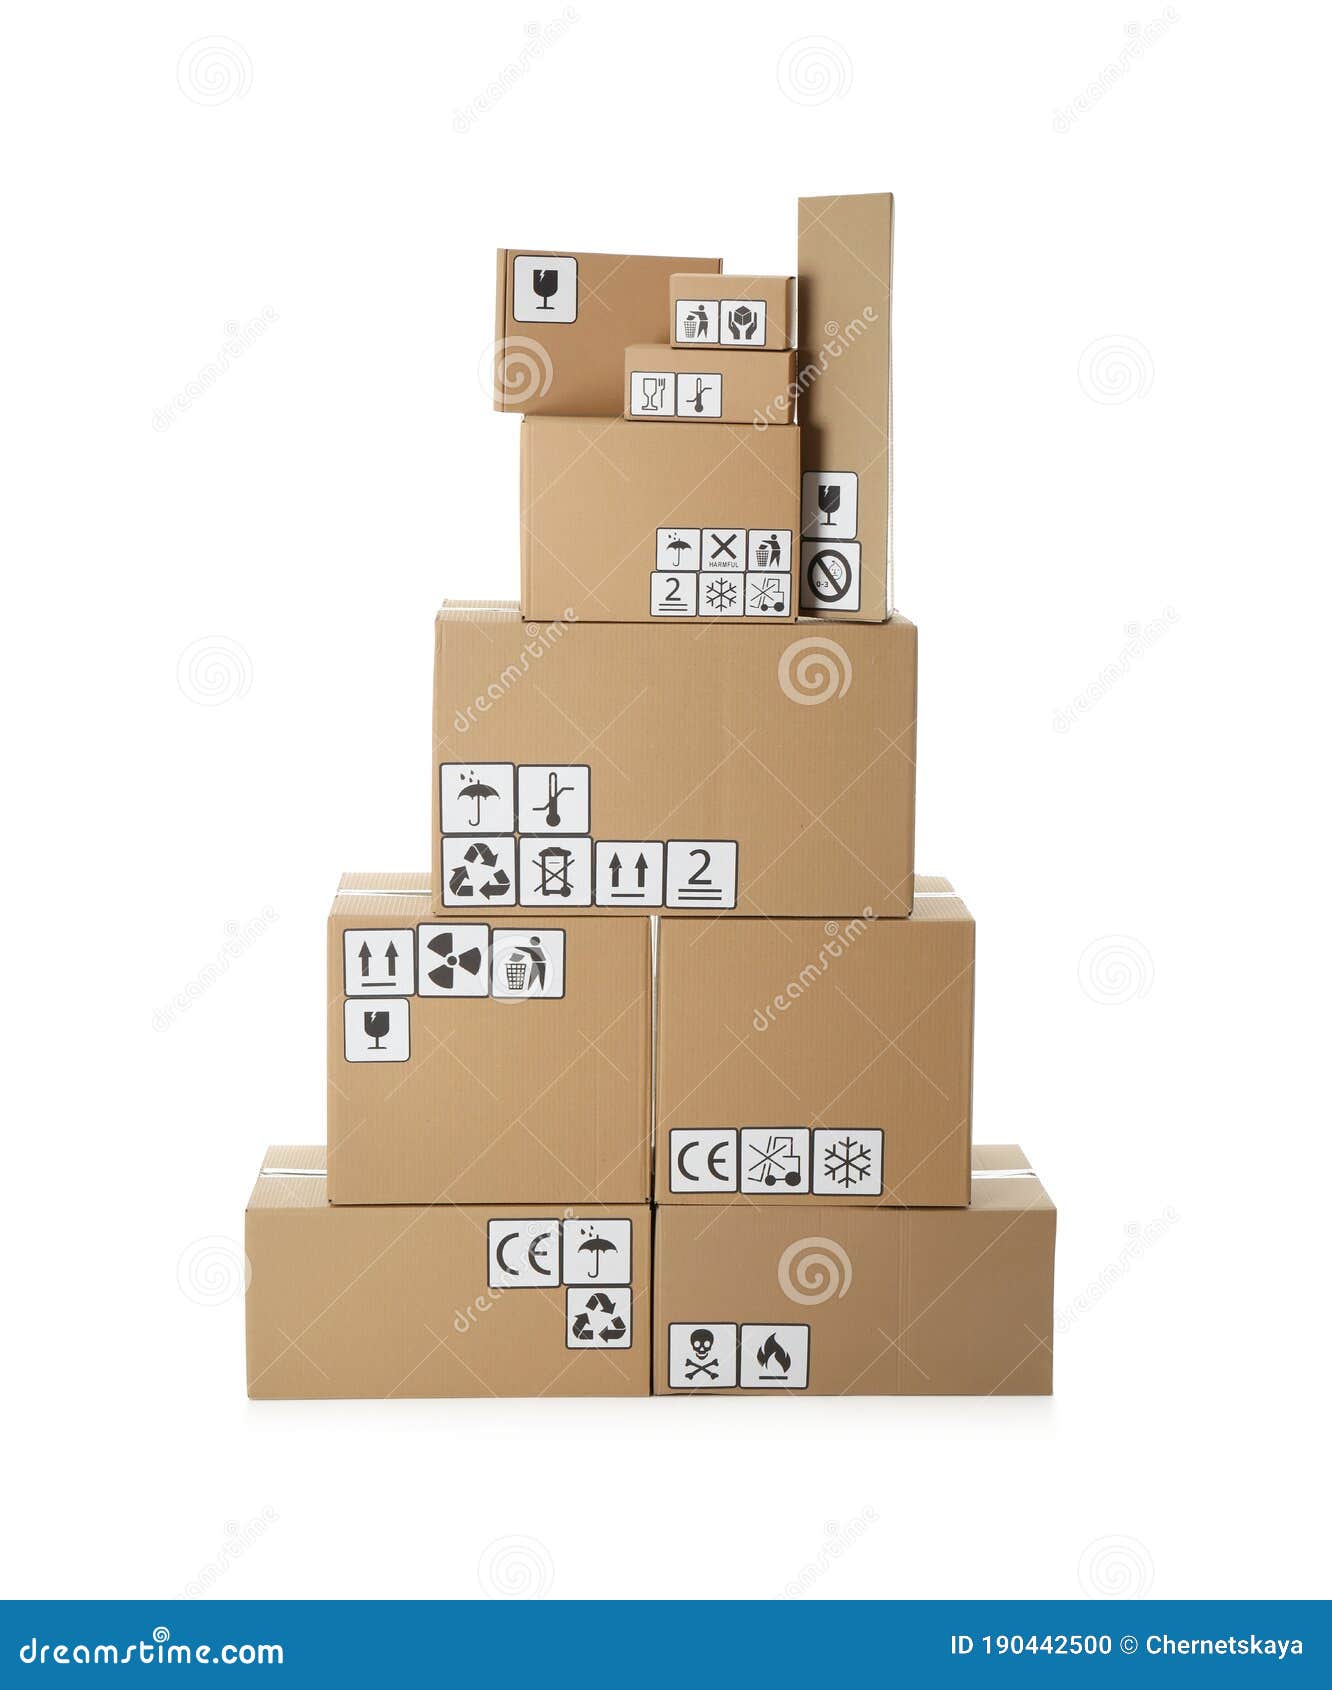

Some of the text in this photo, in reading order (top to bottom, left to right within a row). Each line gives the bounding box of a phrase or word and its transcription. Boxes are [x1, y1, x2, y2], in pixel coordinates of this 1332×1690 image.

[665, 577, 681, 601] 2
[816, 580, 829, 588] 0-3
[688, 848, 712, 885] 2
[677, 1141, 729, 1181] CE
[496, 1232, 551, 1275] CE
